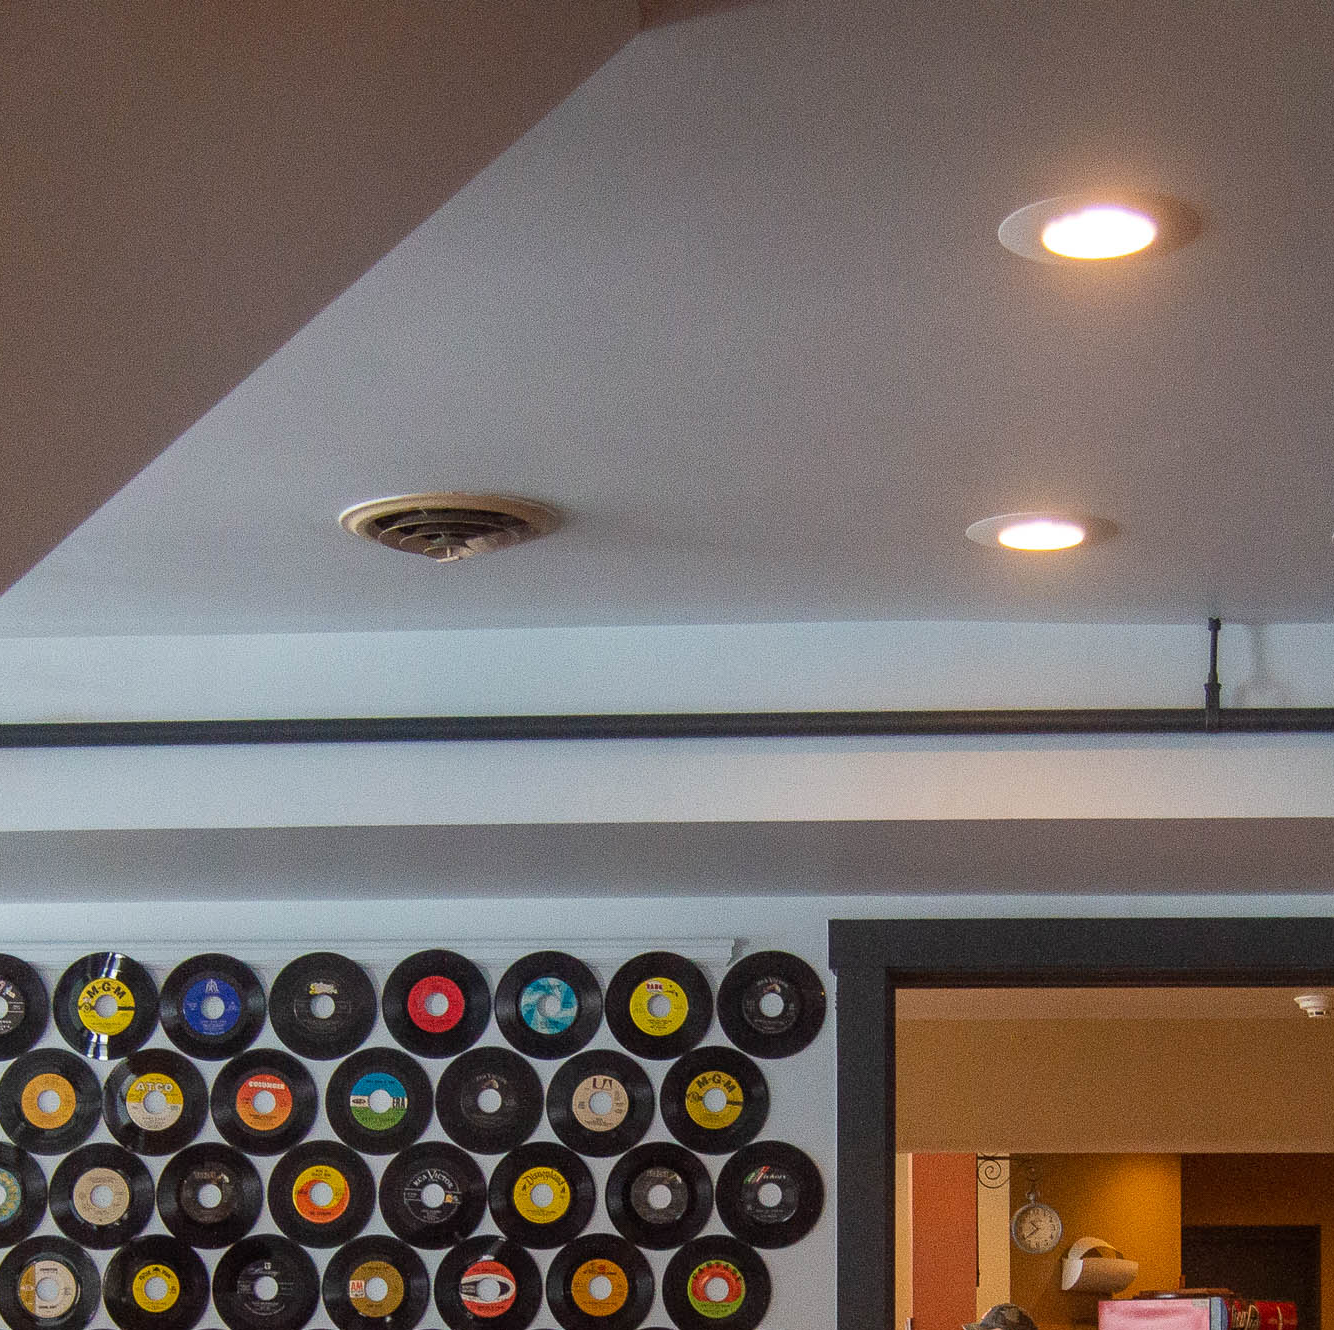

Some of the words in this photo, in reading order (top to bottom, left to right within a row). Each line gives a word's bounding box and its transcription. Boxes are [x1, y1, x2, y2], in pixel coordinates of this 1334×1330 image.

[87, 982, 126, 999] M-G-M
[135, 1081, 174, 1093] ATCO
[696, 1073, 736, 1093] M-G-M
[392, 1096, 406, 1109] ERA
[412, 1174, 427, 1187] RCA
[427, 1169, 454, 1189] VICTOR
[523, 1169, 566, 1187] Disneyland
